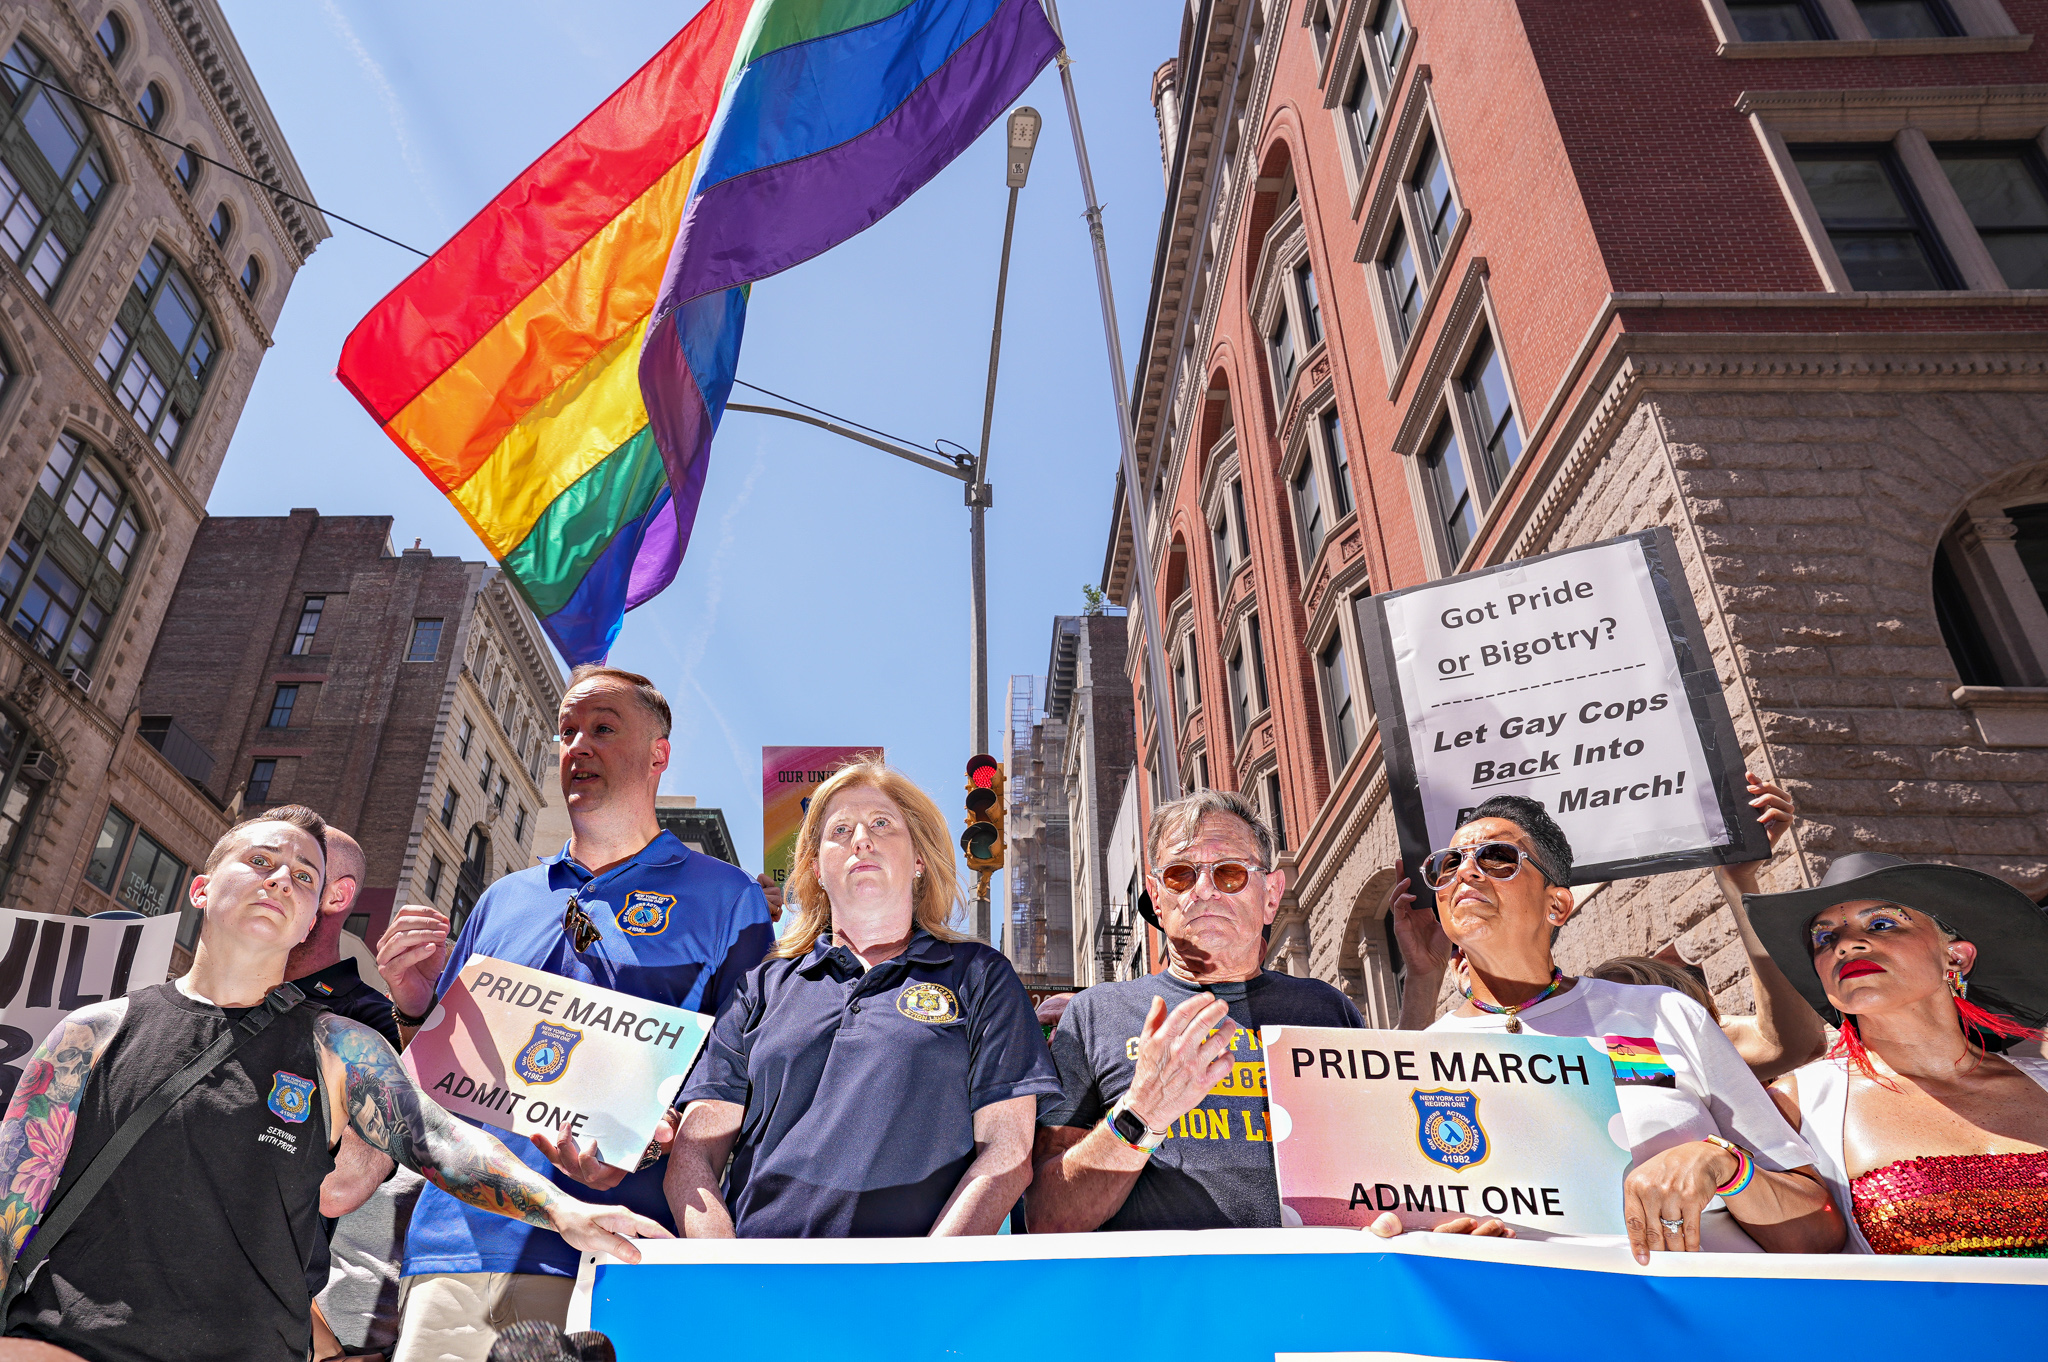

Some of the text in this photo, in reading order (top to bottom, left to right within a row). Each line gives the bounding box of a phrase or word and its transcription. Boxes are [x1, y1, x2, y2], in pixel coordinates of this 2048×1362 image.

[1440, 579, 1595, 629] Got Pride
[1438, 617, 1618, 676] or Bigotry?
[1432, 692, 1669, 753] Let Gay Cops
[778, 770, 804, 782] OUR
[1472, 736, 1645, 785] Back Into
[1557, 771, 1687, 814] March!
[130, 872, 165, 906] TEMPLE
[772, 869, 785, 882] IS
[124, 886, 160, 917] STUDIO
[469, 971, 685, 1050] PRIDE MARCH
[522, 1070, 544, 1082] 41982
[1291, 1047, 1590, 1086] PRIDE MARCH
[432, 1072, 589, 1138] ADMIT ONE
[258, 1134, 298, 1154] WITH PRIDE
[266, 1126, 297, 1143] SERVING
[1425, 1110, 1480, 1152] GAY OFFICERS ACTION LEAGUE
[1442, 1155, 1471, 1163] 41982
[1348, 1182, 1565, 1216] ADMIT ONE
